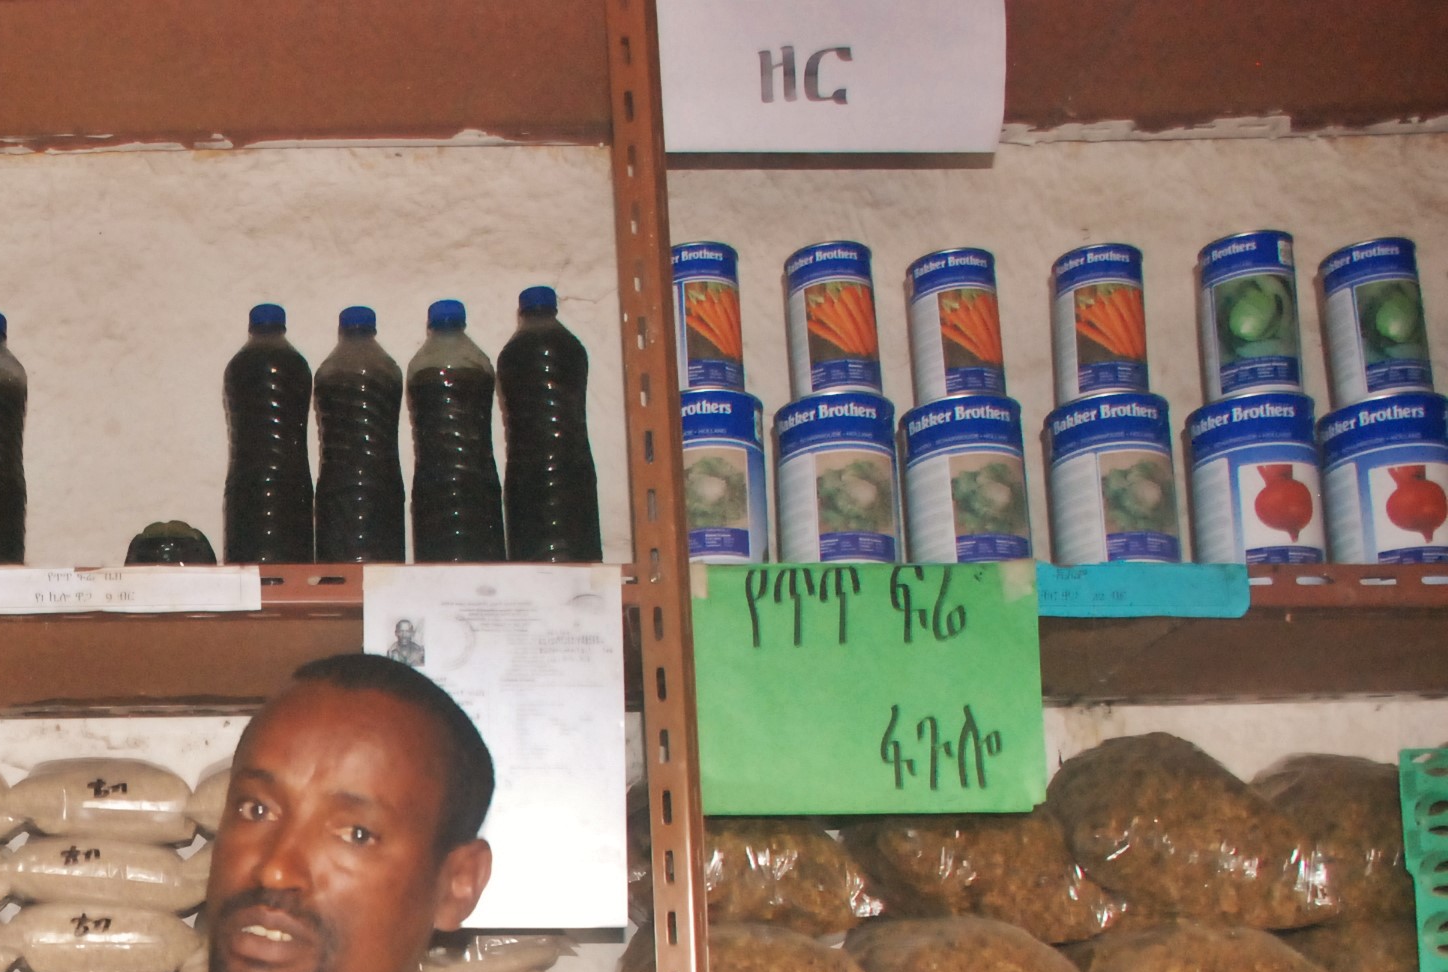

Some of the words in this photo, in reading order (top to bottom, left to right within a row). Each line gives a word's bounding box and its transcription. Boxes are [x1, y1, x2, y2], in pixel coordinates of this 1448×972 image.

[756, 45, 853, 105] ዘር
[815, 248, 858, 261] Brothers
[1086, 251, 1130, 264] Brothers
[1351, 245, 1400, 262] Brothers
[681, 399, 732, 417] rothers
[817, 401, 877, 420] Brothers
[1231, 403, 1295, 422] Brothers
[1358, 404, 1425, 426] Brothers
[908, 411, 952, 436] Bakker
[954, 404, 1011, 423] Brothers
[1053, 410, 1098, 436] Bakker
[1099, 403, 1159, 420] Brothers
